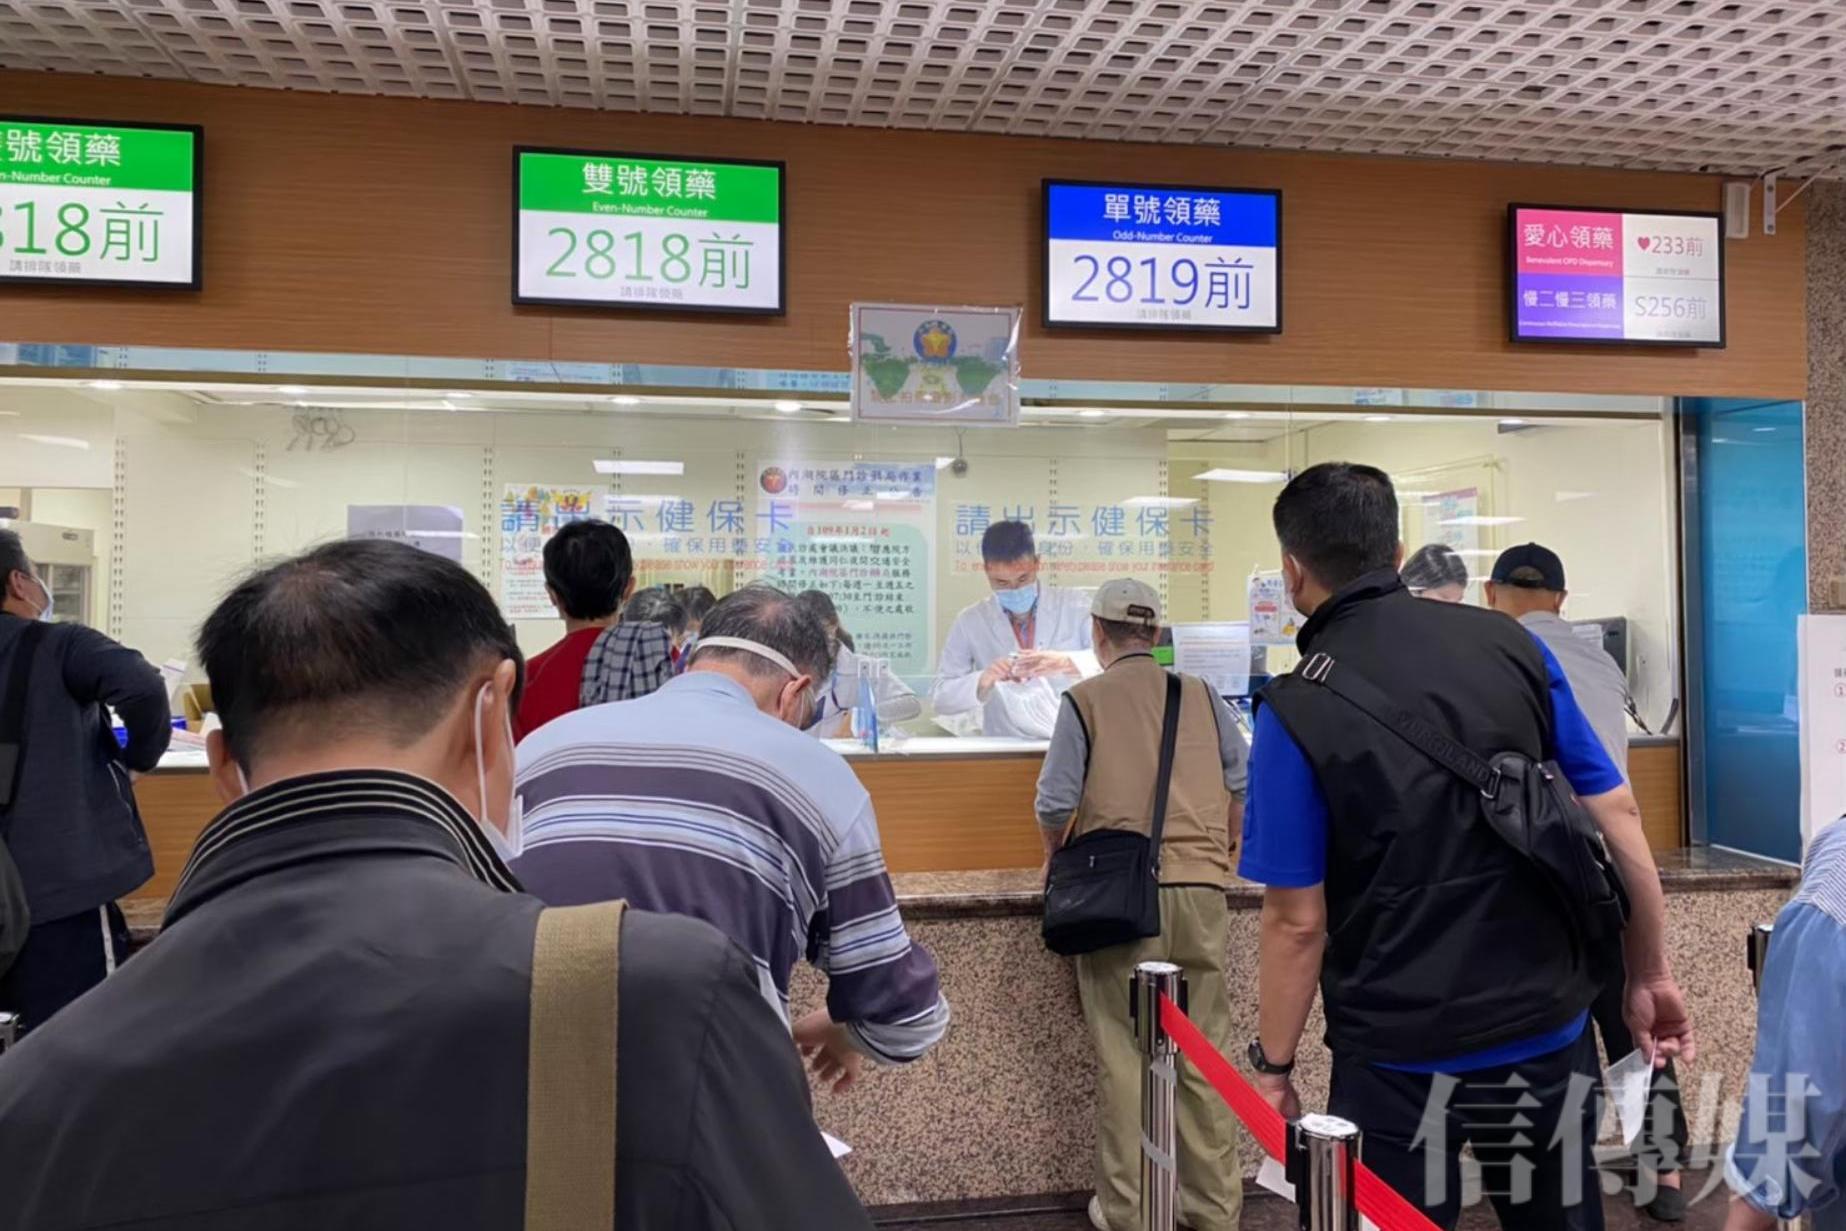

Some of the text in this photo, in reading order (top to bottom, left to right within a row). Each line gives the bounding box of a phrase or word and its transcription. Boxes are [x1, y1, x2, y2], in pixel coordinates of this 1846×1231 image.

[0, 129, 121, 167] 號領藥
[63, 172, 111, 186] Counter
[581, 162, 716, 200] 雙號領藥
[592, 201, 709, 218] Even-Number Counter
[1103, 194, 1222, 226] 單號領藥
[0, 200, 164, 262] 18前
[1112, 230, 1213, 243] Odd-Number Counter
[1524, 223, 1614, 250] 愛心領藥
[545, 227, 754, 289] 2818前
[1071, 254, 1254, 310] 2819前
[1634, 295, 1708, 320] S256前
